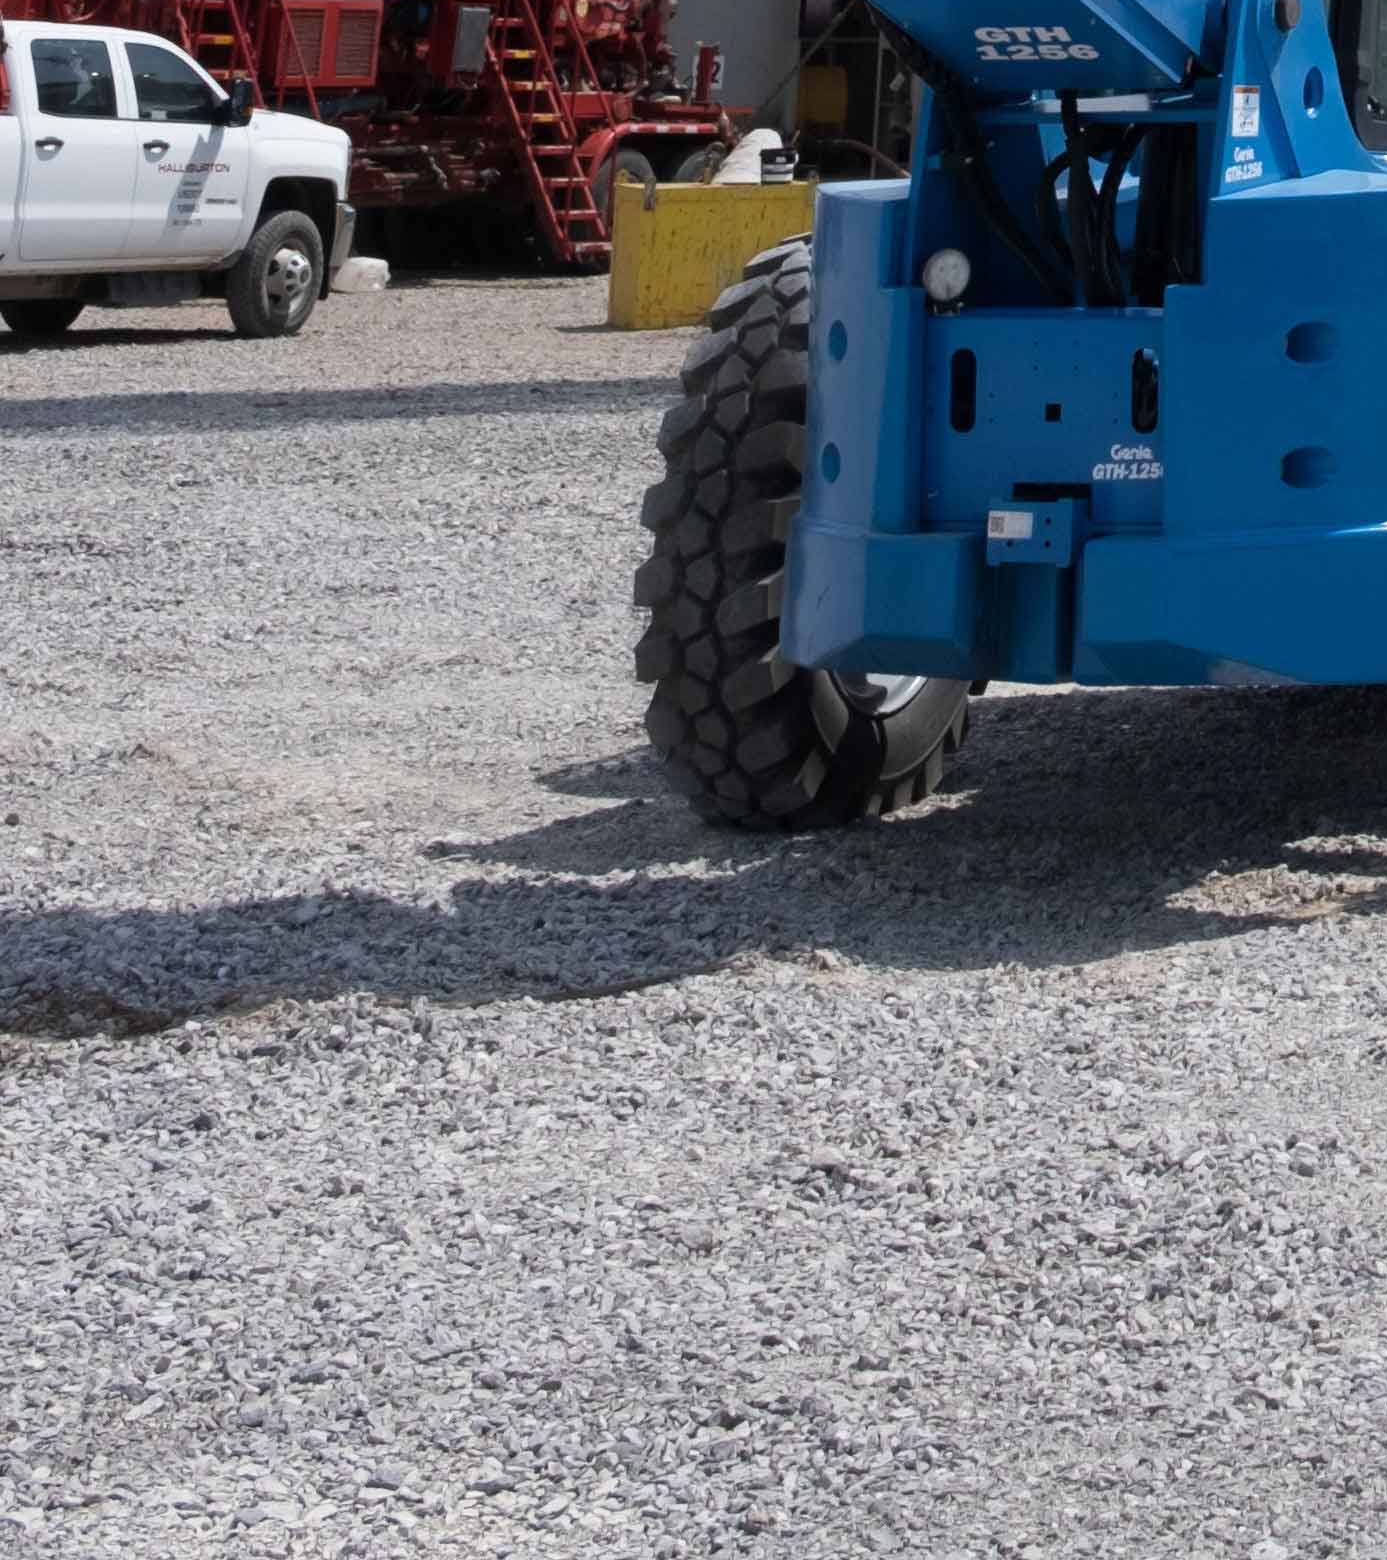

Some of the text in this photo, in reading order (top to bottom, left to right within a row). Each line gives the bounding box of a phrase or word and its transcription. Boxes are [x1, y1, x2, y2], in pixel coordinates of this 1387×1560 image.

[974, 26, 1072, 43] GTH
[976, 44, 1100, 61] 1256
[1110, 443, 1154, 461] Genie
[1092, 462, 1164, 481] GTH-125
